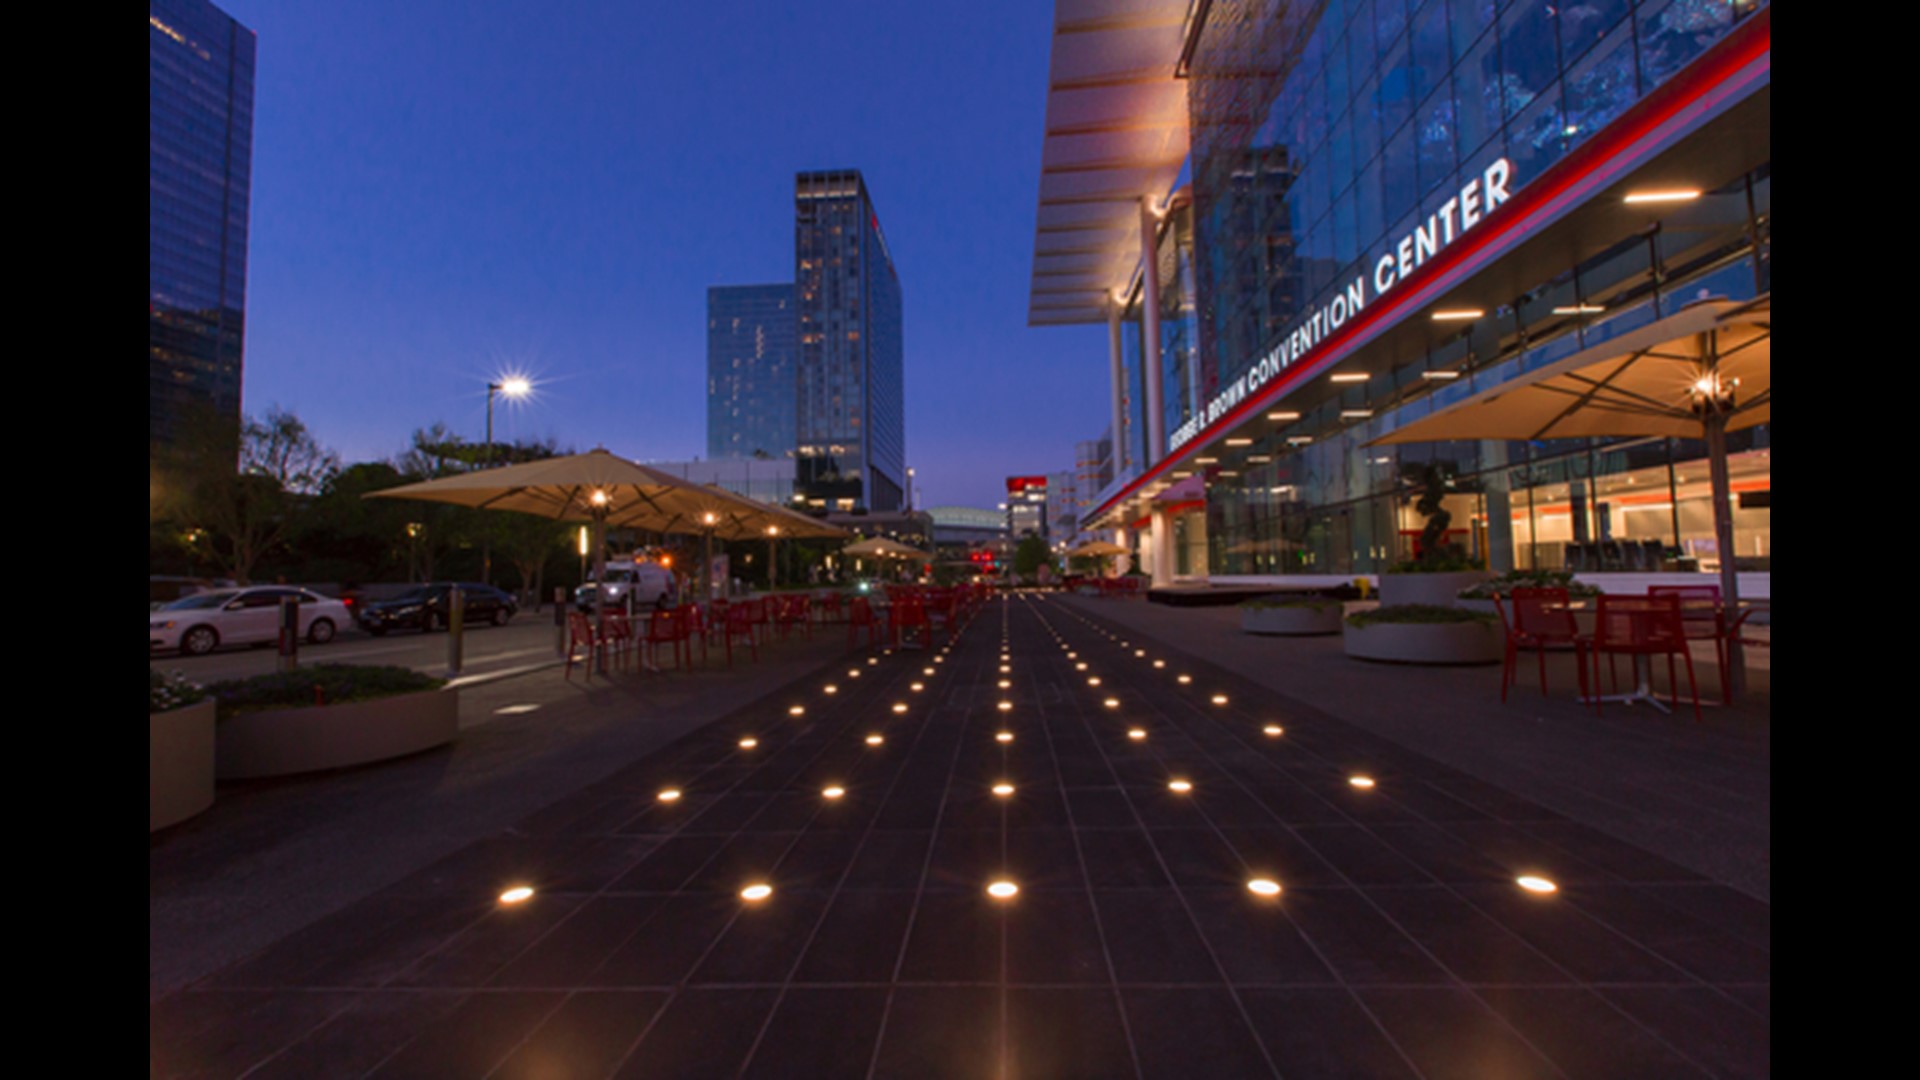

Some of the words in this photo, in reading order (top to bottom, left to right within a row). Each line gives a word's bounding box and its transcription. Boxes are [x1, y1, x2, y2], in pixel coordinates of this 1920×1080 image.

[1208, 375, 1246, 422] BROWN
[1248, 276, 1365, 392] CONVENTION
[1374, 158, 1512, 294] CENTER
